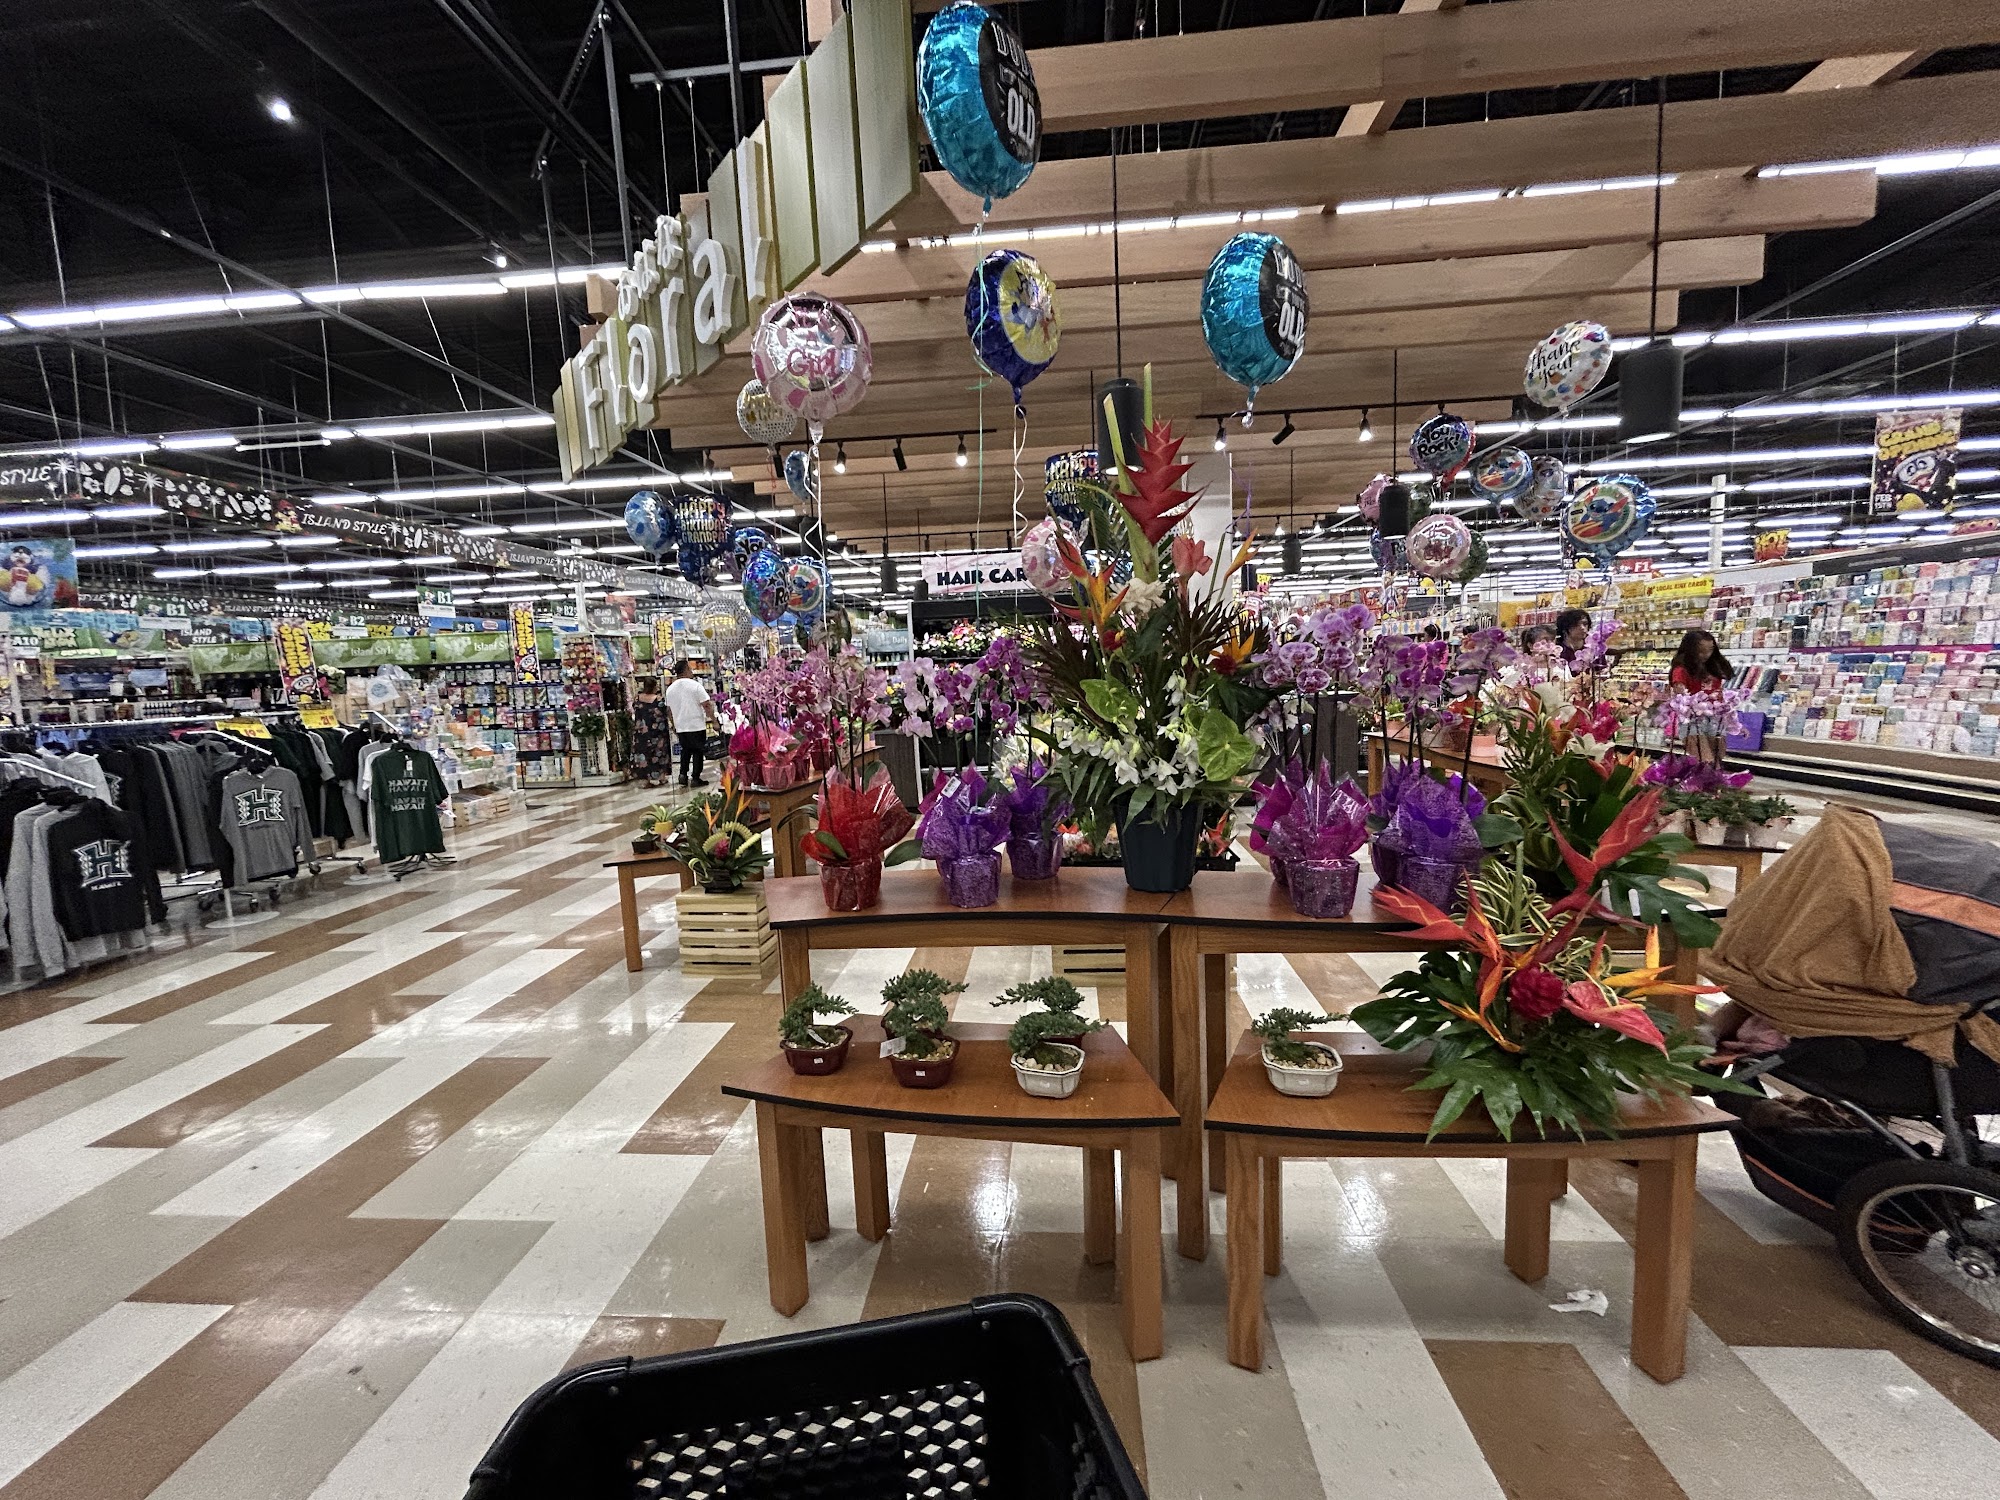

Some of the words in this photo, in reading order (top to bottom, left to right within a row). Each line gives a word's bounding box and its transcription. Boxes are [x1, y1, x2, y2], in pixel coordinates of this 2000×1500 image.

[1007, 87, 1036, 149] OLD
[578, 137, 766, 450] Floral
[1278, 301, 1305, 345] OLD
[1530, 340, 1581, 372] thank
[1538, 355, 1574, 389] you!
[1420, 426, 1450, 444] You
[1416, 433, 1462, 459] Rock!
[0, 466, 52, 486] STYLE
[679, 500, 726, 520] HAPPY
[301, 513, 351, 531] ISLAND
[352, 521, 388, 536] STYLE
[680, 519, 727, 531] BIRTHDAY
[509, 552, 535, 565] ISLAND
[535, 556, 554, 567] STYLE
[1634, 561, 1650, 573] F1
[936, 569, 985, 587] HAIR
[988, 567, 1029, 585] CAR
[437, 590, 453, 604] B1
[166, 603, 188, 617] B1
[350, 615, 365, 626] B2
[464, 623, 475, 632] B3
[12, 636, 39, 646] A10
[180, 628, 212, 637] ISLAND
[191, 636, 217, 644] STYLE
[235, 788, 285, 827] H
[74, 839, 132, 888] H
